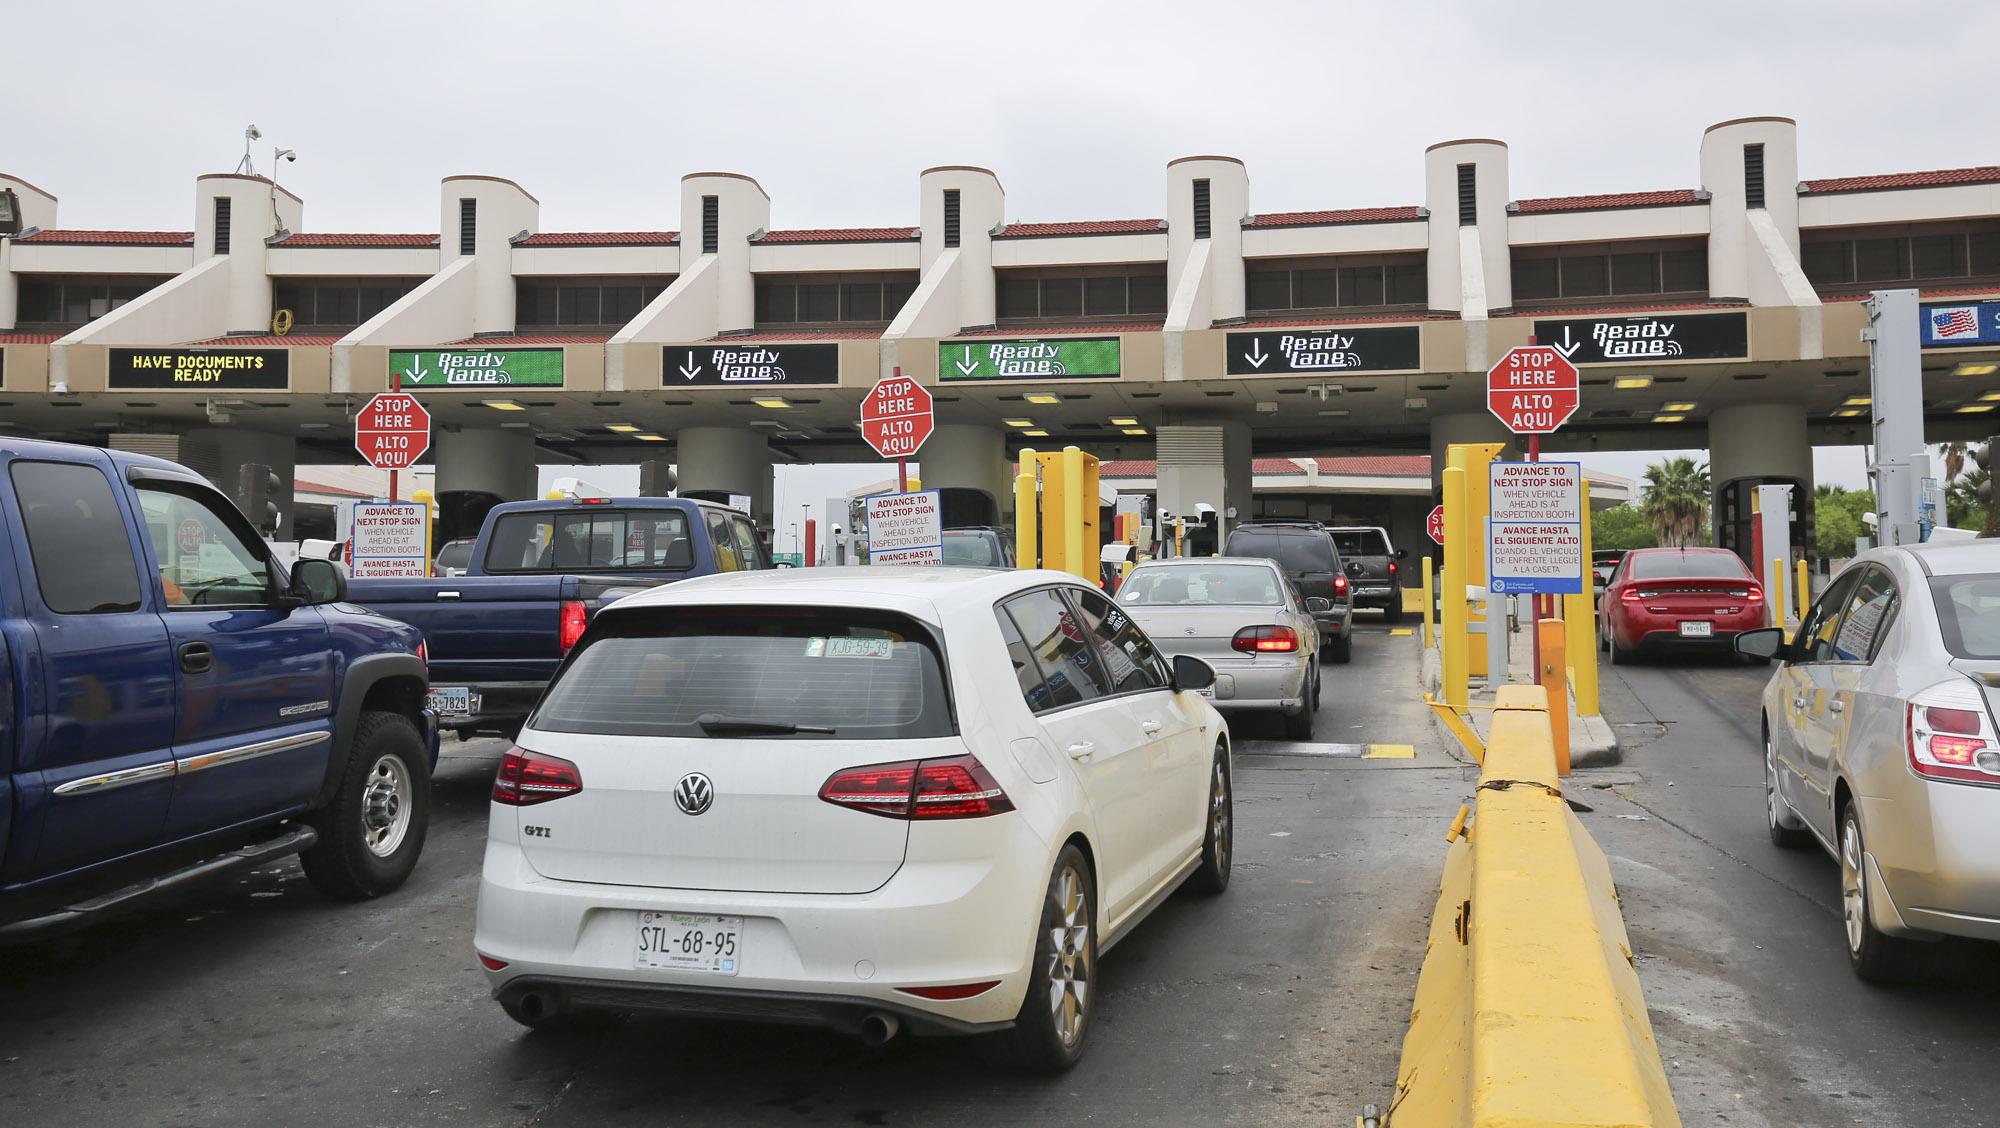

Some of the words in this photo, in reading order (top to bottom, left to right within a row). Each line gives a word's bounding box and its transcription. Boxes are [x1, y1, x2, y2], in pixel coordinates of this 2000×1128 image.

[1593, 321, 1675, 346] Ready
[1280, 334, 1354, 357] Ready
[1604, 340, 1668, 358] Lane
[712, 349, 780, 370] Ready
[989, 343, 1059, 365] Ready
[1290, 352, 1348, 368] Lane
[1510, 353, 1554, 368] STOP
[133, 356, 172, 369] HAVE
[178, 356, 264, 369] DOCUMENTS
[438, 353, 506, 373] Ready
[999, 360, 1053, 376] Lane
[174, 369, 222, 382] READY
[447, 368, 499, 384] Lane
[721, 365, 773, 381] Lane
[1510, 370, 1556, 385] HERE
[877, 382, 912, 399] STOP
[375, 400, 411, 412] STOP
[878, 397, 914, 415] HERE
[1511, 395, 1553, 410] ALTO
[375, 415, 412, 428] HERE
[1511, 412, 1553, 430] AQUI
[881, 420, 913, 437] ALTO
[375, 436, 409, 449] ALTO
[882, 436, 914, 453] AQUI
[375, 452, 408, 467] AQUI
[1503, 467, 1550, 476] ADVANCE
[1553, 467, 1565, 475] TO
[1494, 479, 1519, 487] NEXT
[1522, 479, 1547, 487] STOP
[1549, 478, 1573, 487] SIGN
[1503, 490, 1529, 498] WHEN
[1531, 490, 1566, 498] VEHICLE
[877, 497, 915, 508] ADVANCE
[917, 496, 927, 504] TO
[1550, 500, 1560, 508] AT
[870, 510, 890, 519] NEXT
[893, 508, 913, 517] STOP
[915, 505, 934, 514] SIGN
[878, 520, 899, 528] WHEN
[901, 517, 929, 526] VEHICLE
[1432, 514, 1444, 525] ST
[182, 526, 201, 536] STOP
[884, 529, 907, 537] AHEAD
[1433, 526, 1444, 536] AL
[1503, 527, 1538, 535] AVANCE
[1540, 527, 1569, 535] HASTA
[871, 538, 912, 548] INSPECTION
[913, 535, 937, 544] BOOTH
[1494, 537, 1505, 545] EL
[1507, 537, 1554, 545] SIGUIENTE
[1556, 537, 1579, 545] ALTO
[880, 553, 908, 561] AVANCE
[910, 551, 933, 559] HASTA
[444, 697, 466, 709] 7829
[674, 772, 714, 816] VW
[524, 825, 551, 838] GTI
[639, 926, 736, 956] STL-68-95
